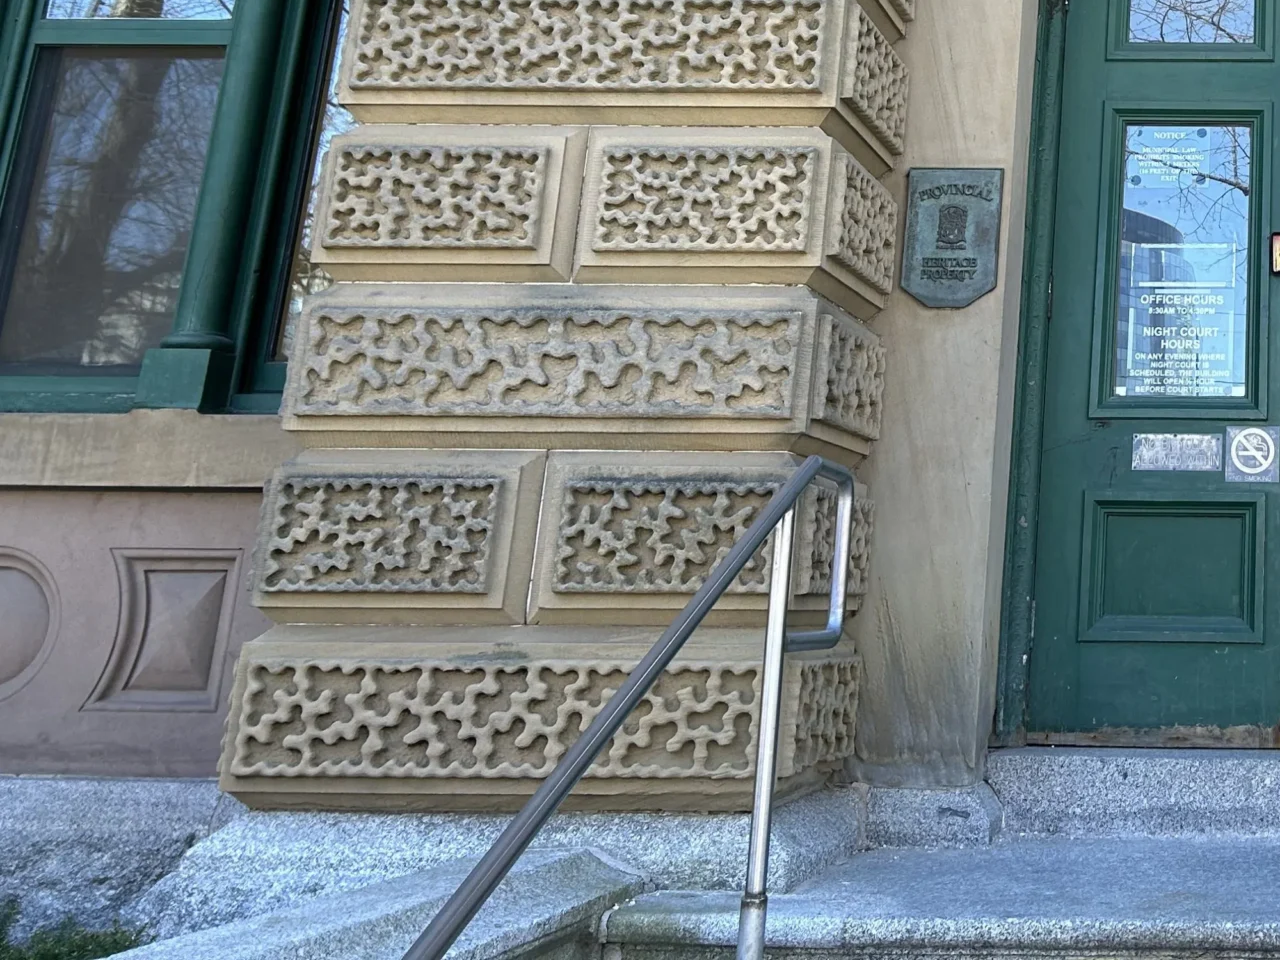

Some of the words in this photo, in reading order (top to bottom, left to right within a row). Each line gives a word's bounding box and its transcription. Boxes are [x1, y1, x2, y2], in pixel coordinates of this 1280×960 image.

[918, 184, 994, 202] PROVINCIAL
[922, 257, 977, 269] HERITAGE
[920, 270, 977, 282] PROPERTY
[1140, 295, 1181, 304] OFFICE
[1184, 295, 1224, 305] HOURS
[1143, 327, 1177, 337] NIGHT
[1180, 327, 1218, 337] COURT
[1161, 340, 1200, 349] HOURS
[1134, 454, 1182, 465] ALLOWED
